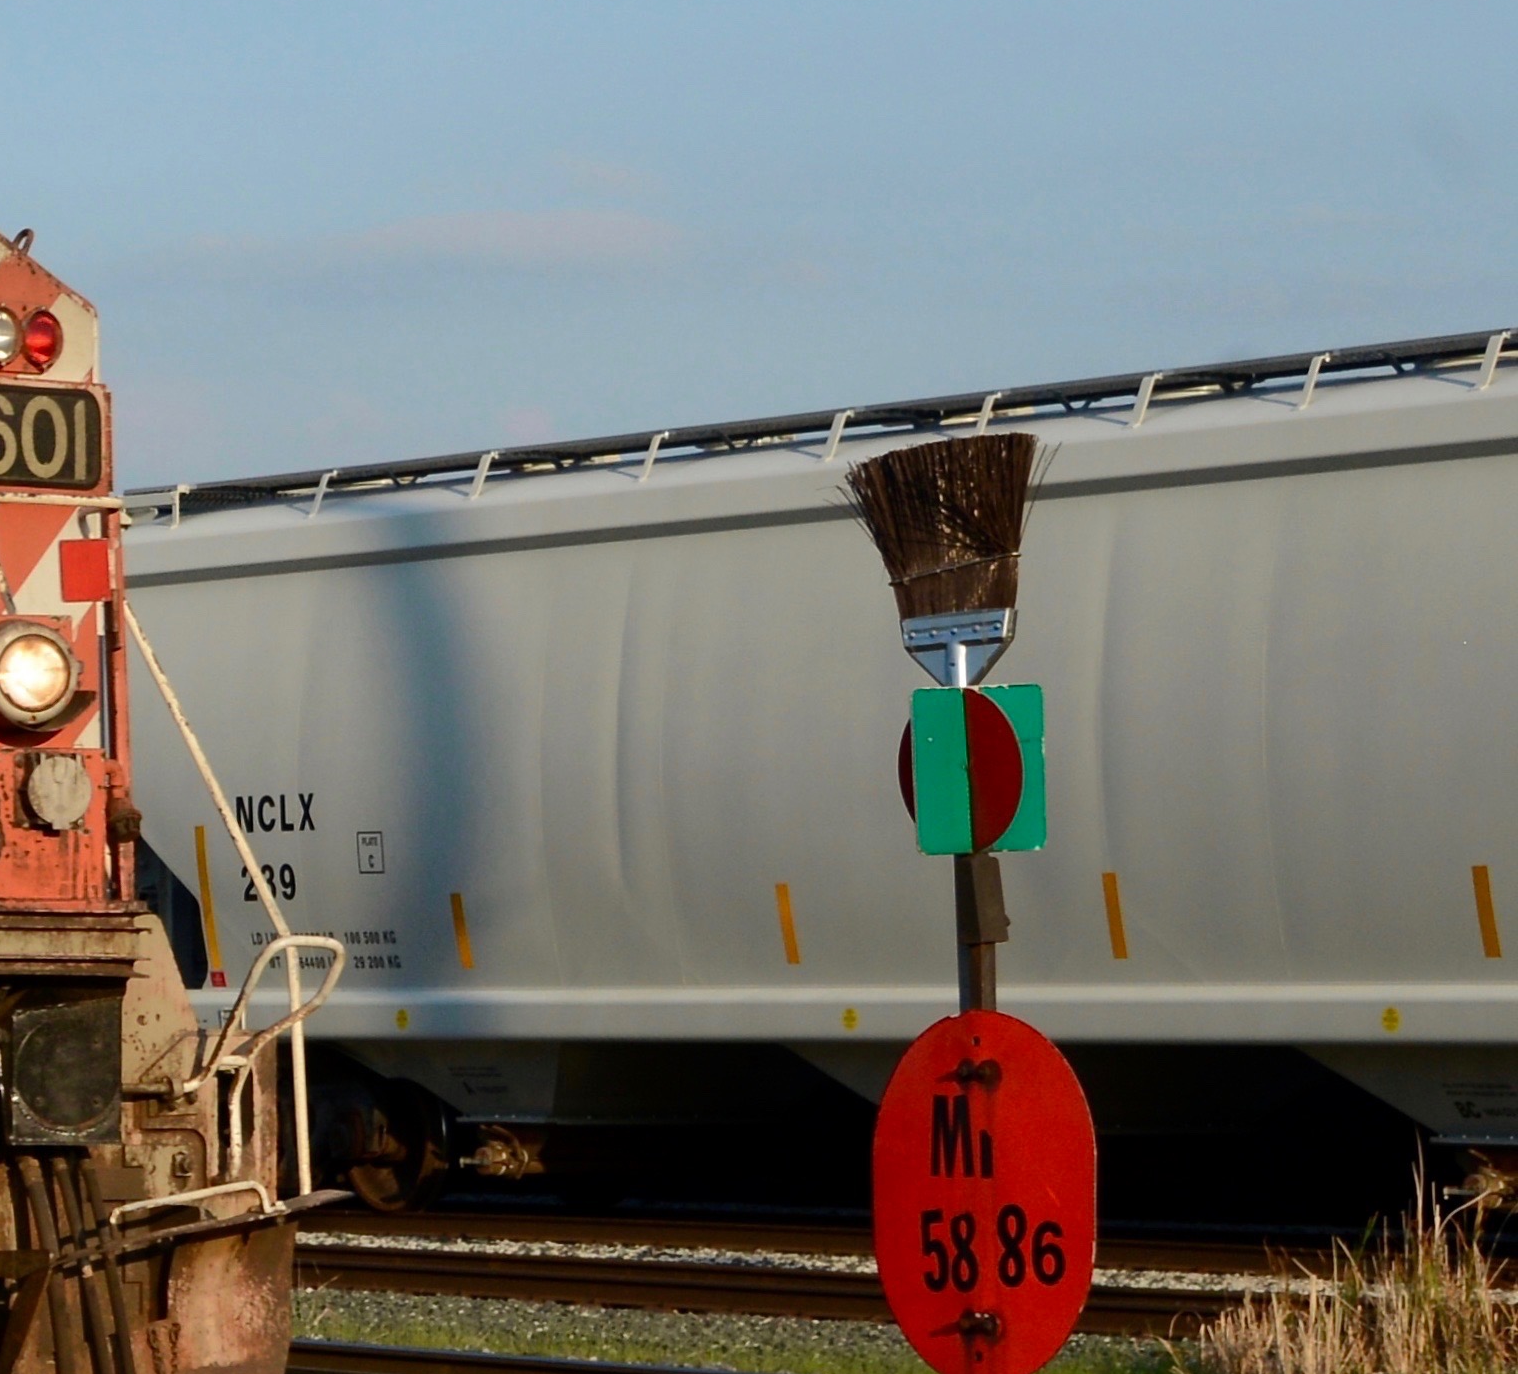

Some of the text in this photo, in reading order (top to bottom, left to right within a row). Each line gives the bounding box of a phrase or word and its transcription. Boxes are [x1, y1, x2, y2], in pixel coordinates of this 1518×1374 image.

[235, 792, 316, 833] NCLX
[363, 930, 380, 944] 500
[382, 930, 397, 944] KG
[387, 954, 402, 969] KG
